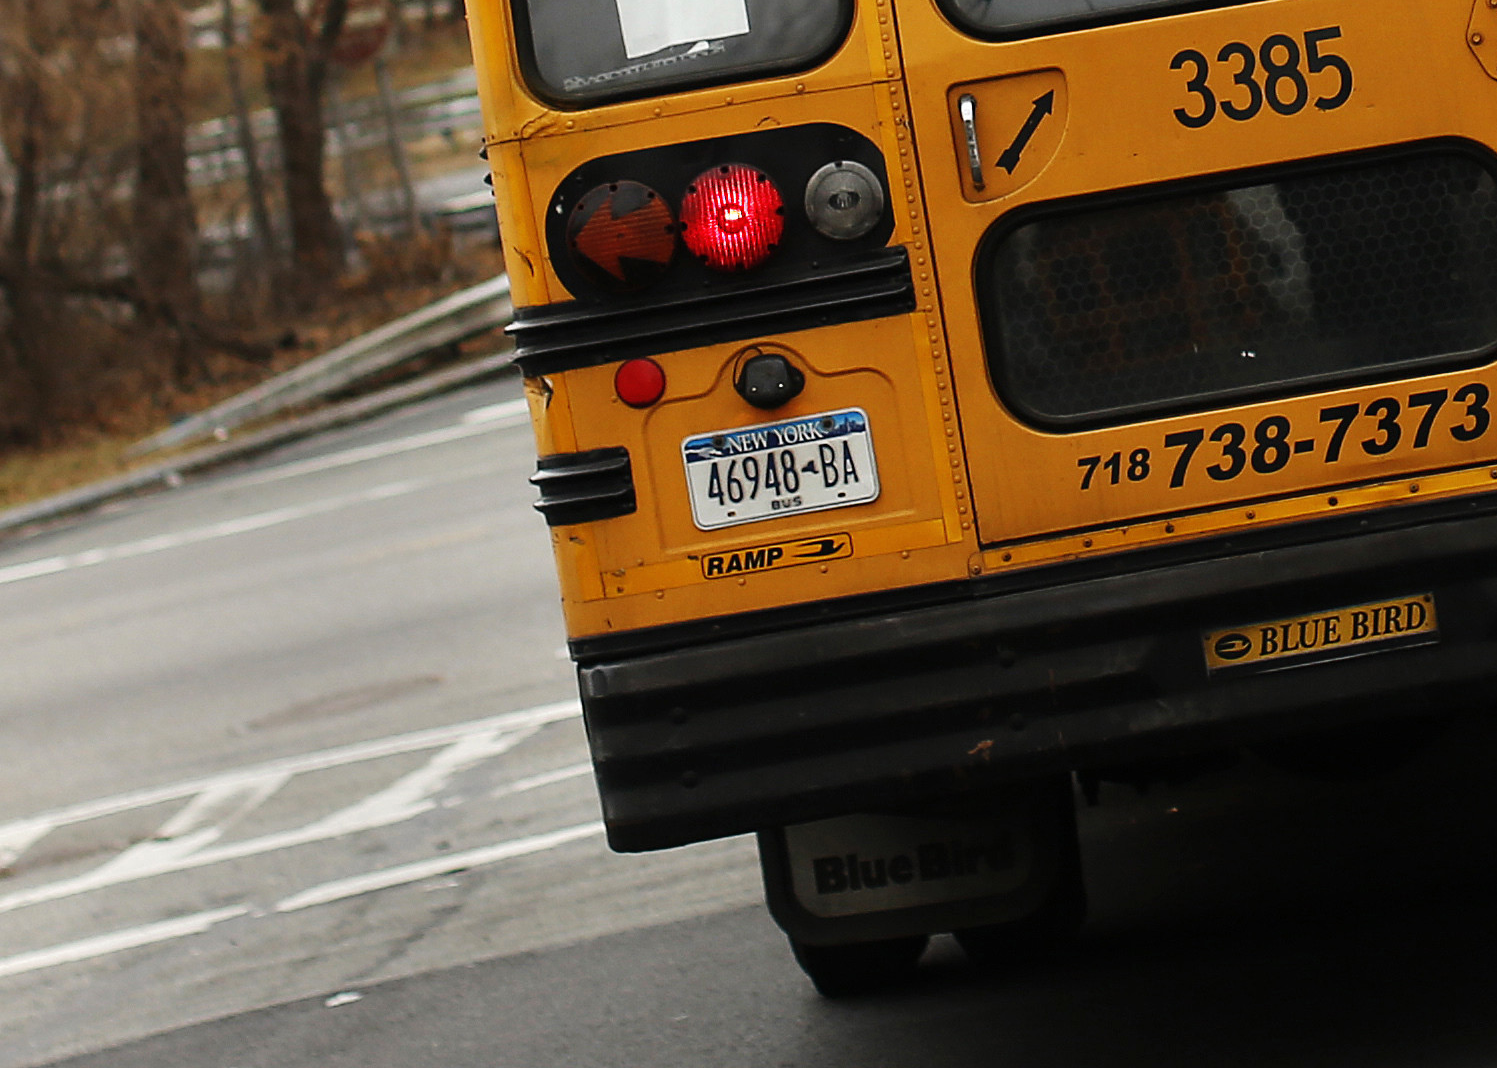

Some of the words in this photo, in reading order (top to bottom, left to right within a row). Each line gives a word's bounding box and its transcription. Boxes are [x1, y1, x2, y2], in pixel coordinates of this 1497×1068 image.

[1169, 25, 1353, 129] 3385
[728, 430, 770, 455] NEW
[773, 421, 822, 446] YORK
[1076, 445, 1150, 491] 718
[1163, 382, 1491, 489] 738-7373
[771, 496, 803, 511] BUS
[706, 546, 784, 577] RAMP
[1259, 616, 1341, 656] BLUE
[1350, 601, 1427, 640] BIRD
